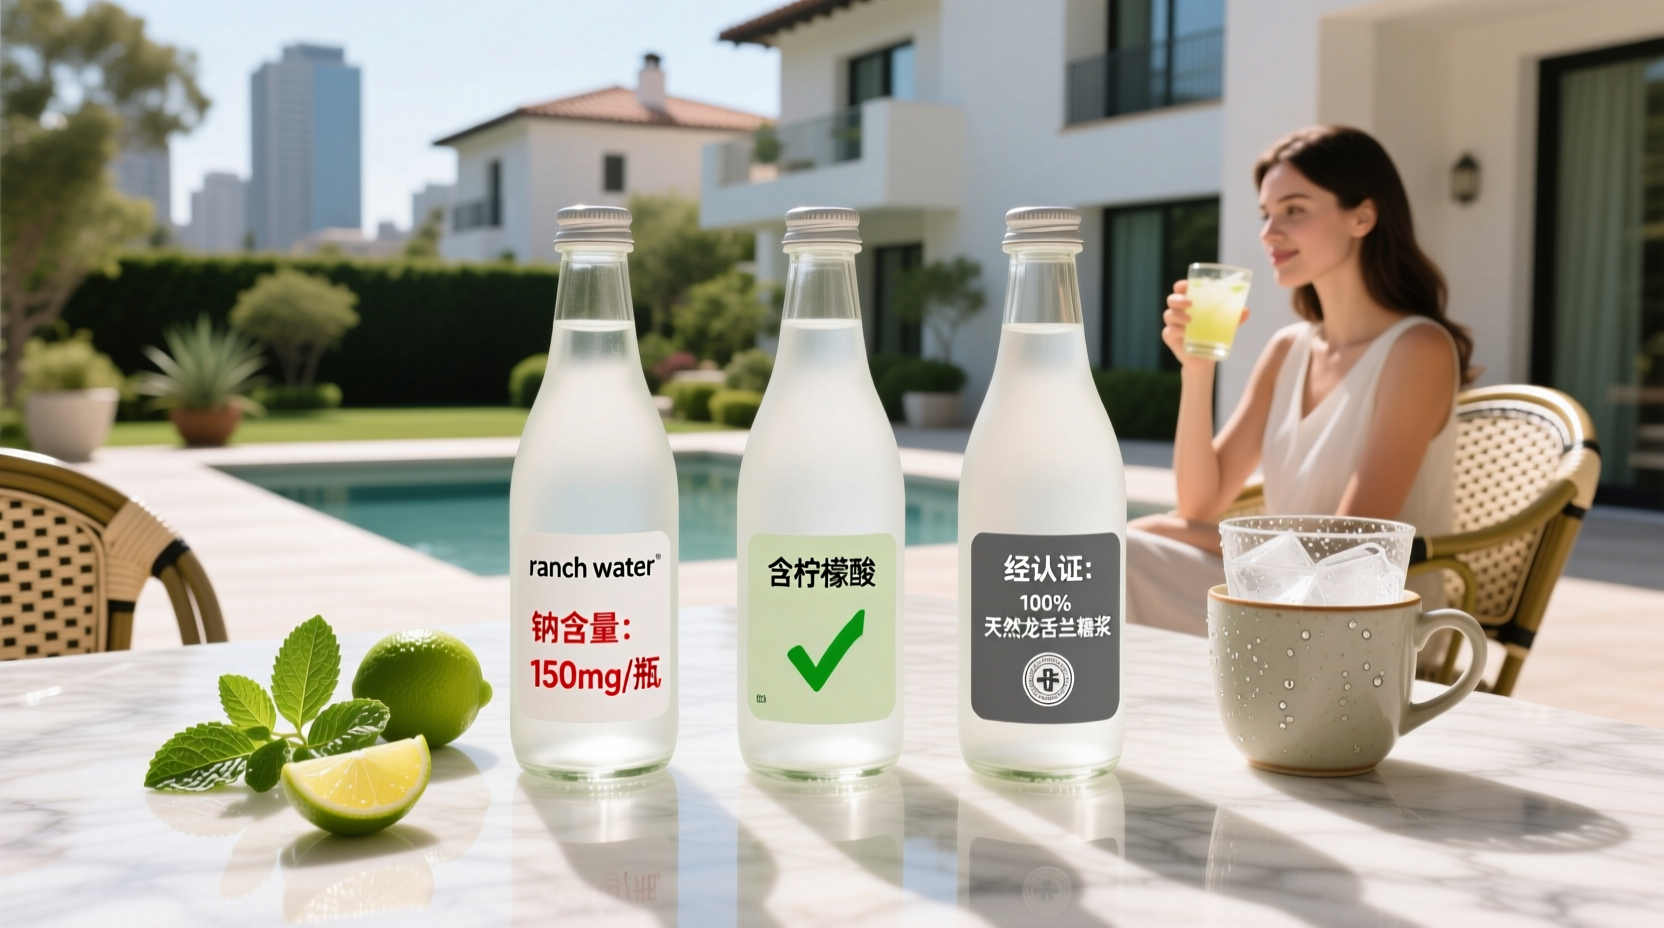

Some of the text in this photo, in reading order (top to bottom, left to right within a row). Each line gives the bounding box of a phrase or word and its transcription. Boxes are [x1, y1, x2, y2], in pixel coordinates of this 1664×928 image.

[529, 556, 587, 578] ranch
[768, 556, 876, 588] 含柠檬酸
[1003, 554, 1092, 583] 经认证：
[1019, 594, 1072, 612] 100%
[531, 610, 631, 644] 钠含量：
[530, 655, 662, 696] 150mg/瓶
